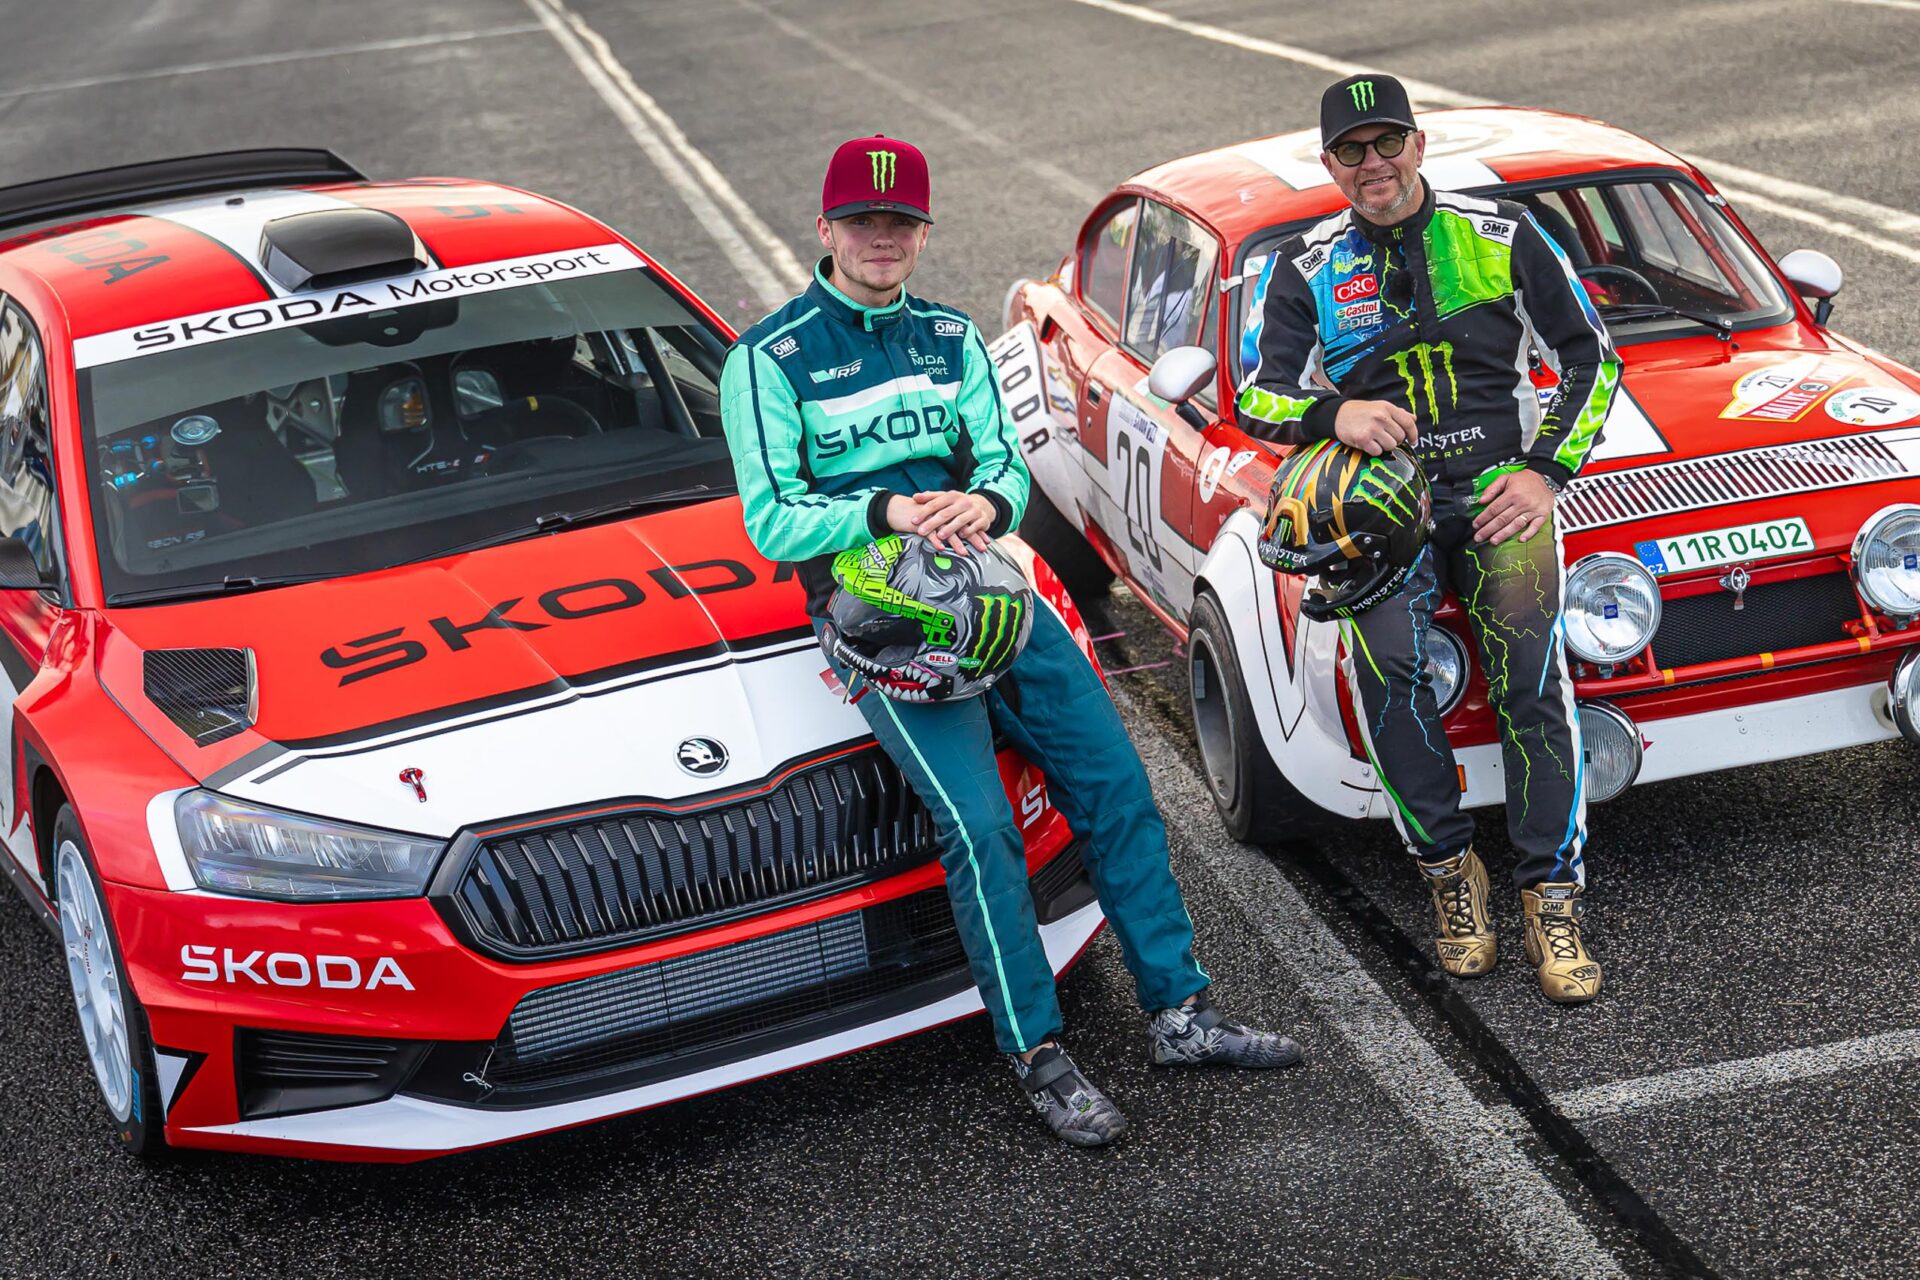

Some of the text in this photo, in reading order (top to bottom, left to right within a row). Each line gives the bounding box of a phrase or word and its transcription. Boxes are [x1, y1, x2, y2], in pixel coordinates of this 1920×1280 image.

[1482, 221, 1509, 236] OMP
[1301, 249, 1324, 270] OMP
[1337, 277, 1375, 300] CRC
[133, 251, 610, 350] SKODA Motorsport
[1346, 302, 1377, 317] Castrol
[934, 321, 964, 335] OMP
[1338, 312, 1384, 331] EDGE
[772, 337, 798, 357] OMP
[1757, 375, 1796, 390] 20
[1750, 391, 1819, 420] RALLYE
[1849, 396, 1898, 414] 20
[1411, 426, 1486, 450] NSTER
[1117, 430, 1163, 573] 20
[1667, 522, 1808, 566] 11R 0402
[1258, 542, 1308, 567] MONSTER
[1649, 563, 1666, 575] CZ
[1351, 564, 1408, 612] MONSTER
[929, 654, 954, 663] BELL
[1022, 784, 1051, 829] S
[1541, 902, 1565, 912] OMP
[1440, 945, 1468, 959] OMP
[181, 944, 416, 991] SKODA
[1572, 966, 1598, 980] OMP
